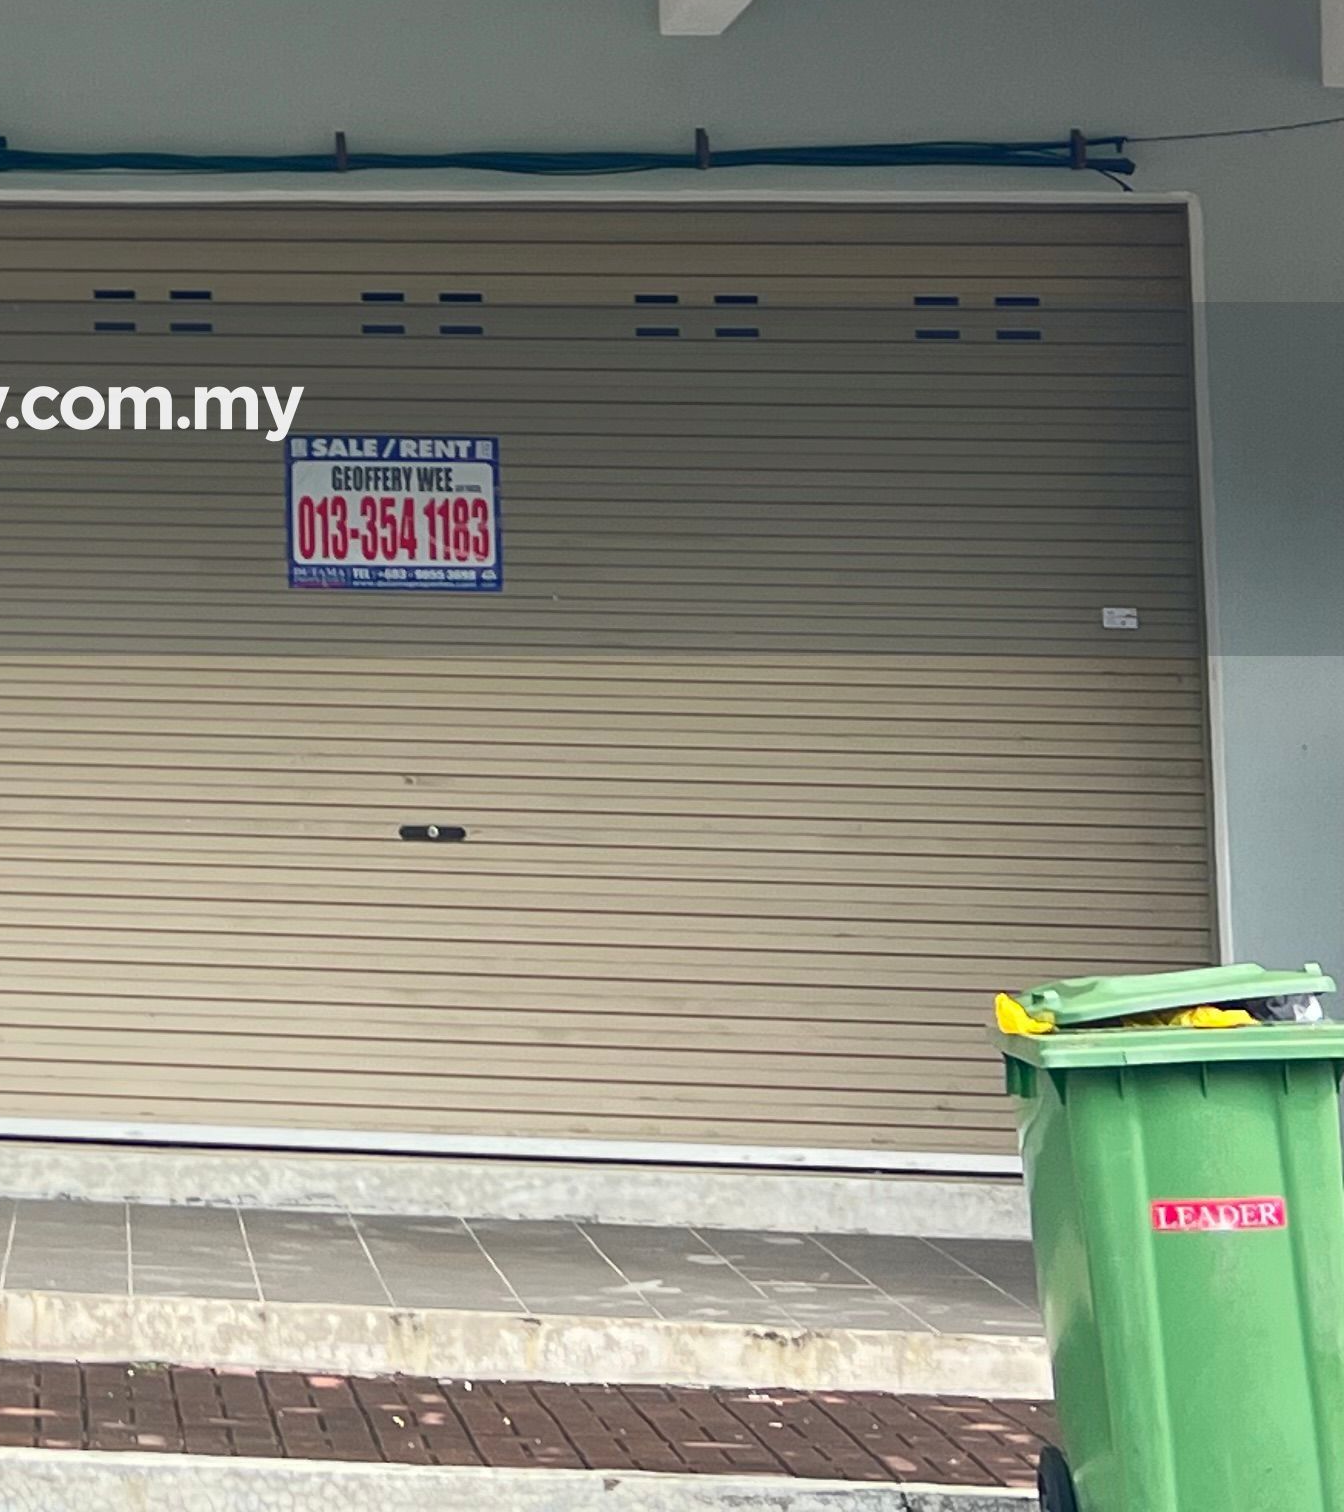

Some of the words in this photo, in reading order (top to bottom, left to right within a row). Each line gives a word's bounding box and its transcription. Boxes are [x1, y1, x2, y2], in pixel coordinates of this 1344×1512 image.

[312, 439, 378, 458] SALE
[400, 440, 472, 458] RENT
[331, 465, 412, 492] GEOFFERY
[417, 467, 453, 493] WEE
[298, 495, 417, 561] 013-354
[423, 497, 490, 561] 1183
[1157, 1202, 1281, 1228] LEADER
